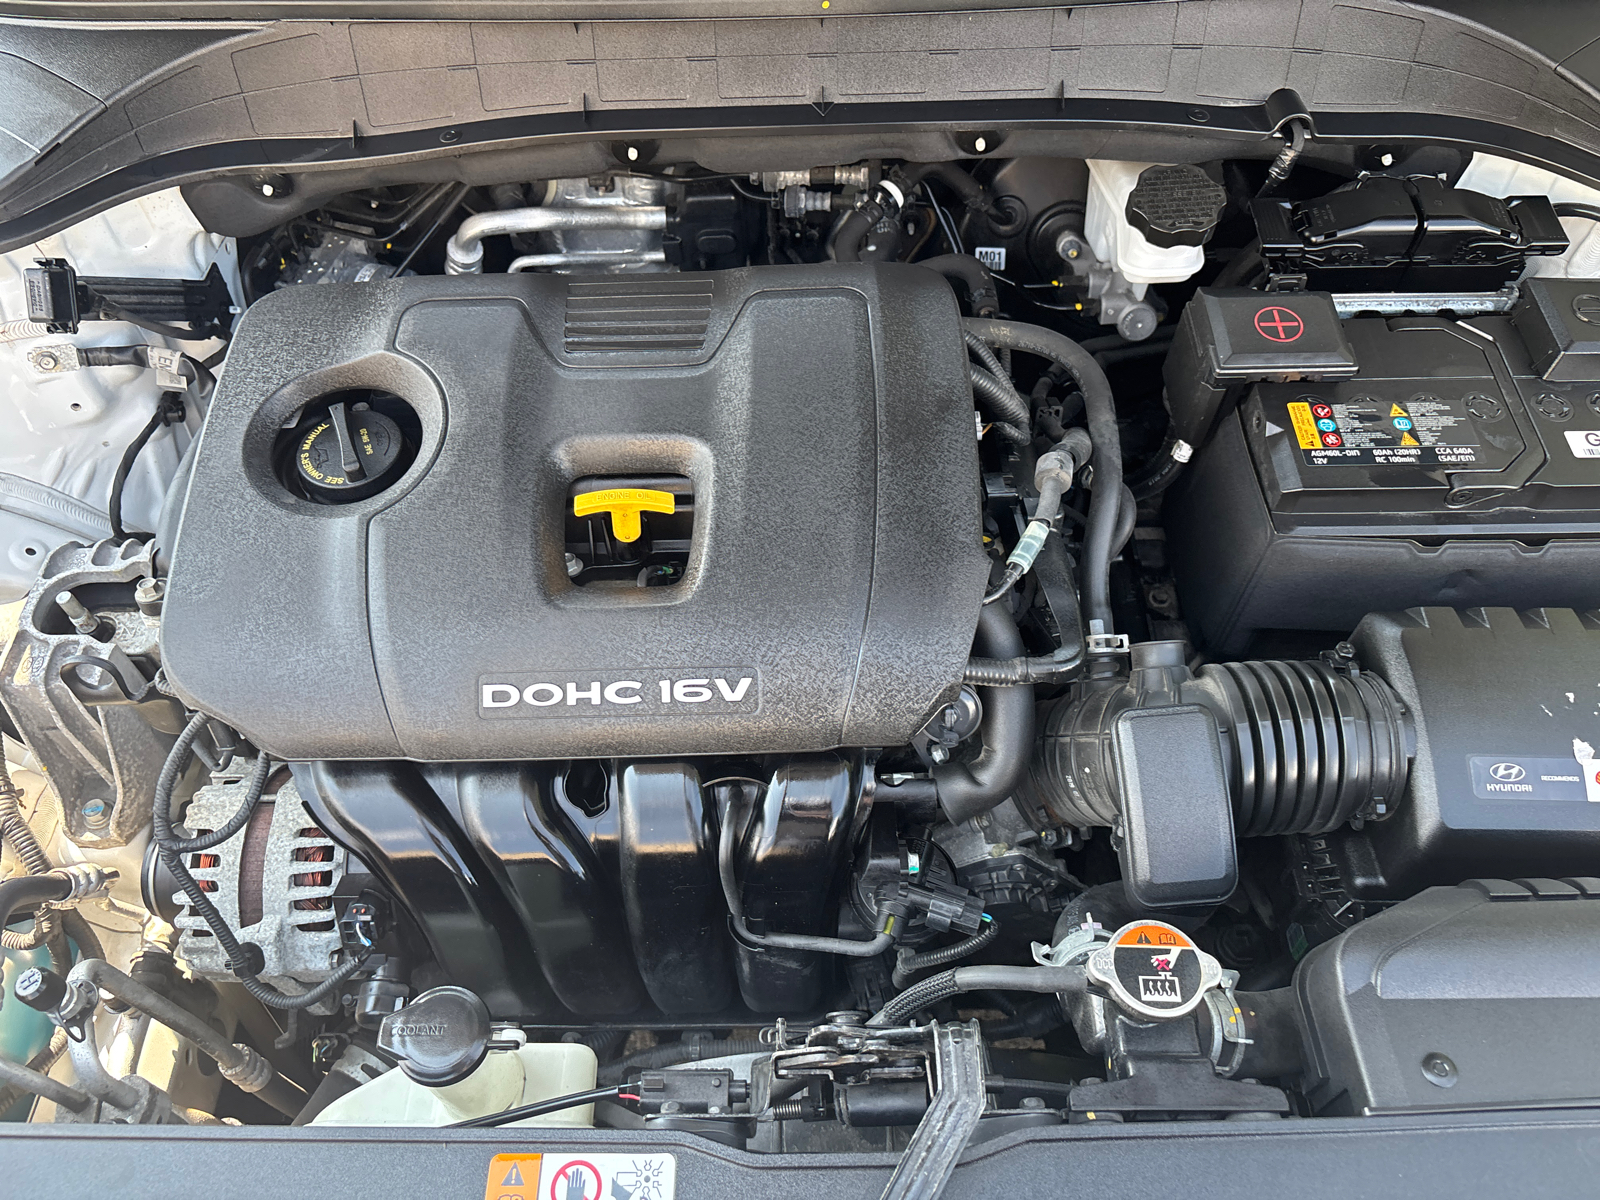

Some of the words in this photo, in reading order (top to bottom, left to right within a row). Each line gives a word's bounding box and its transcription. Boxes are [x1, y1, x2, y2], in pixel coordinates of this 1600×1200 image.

[978, 251, 1002, 262] M01
[302, 422, 330, 450] MANUAL
[363, 443, 374, 455] SAE
[1372, 448, 1393, 456] 60Ah
[1394, 448, 1421, 456] (20HR)
[1453, 447, 1474, 455] 640A
[300, 452, 324, 480] OWNER'S
[324, 476, 345, 484] SEE
[596, 491, 632, 500] ENGINE
[636, 491, 652, 500] OIL
[482, 680, 643, 708] DOHC
[659, 677, 753, 704] 16V
[1486, 783, 1533, 792] HYUNDAI
